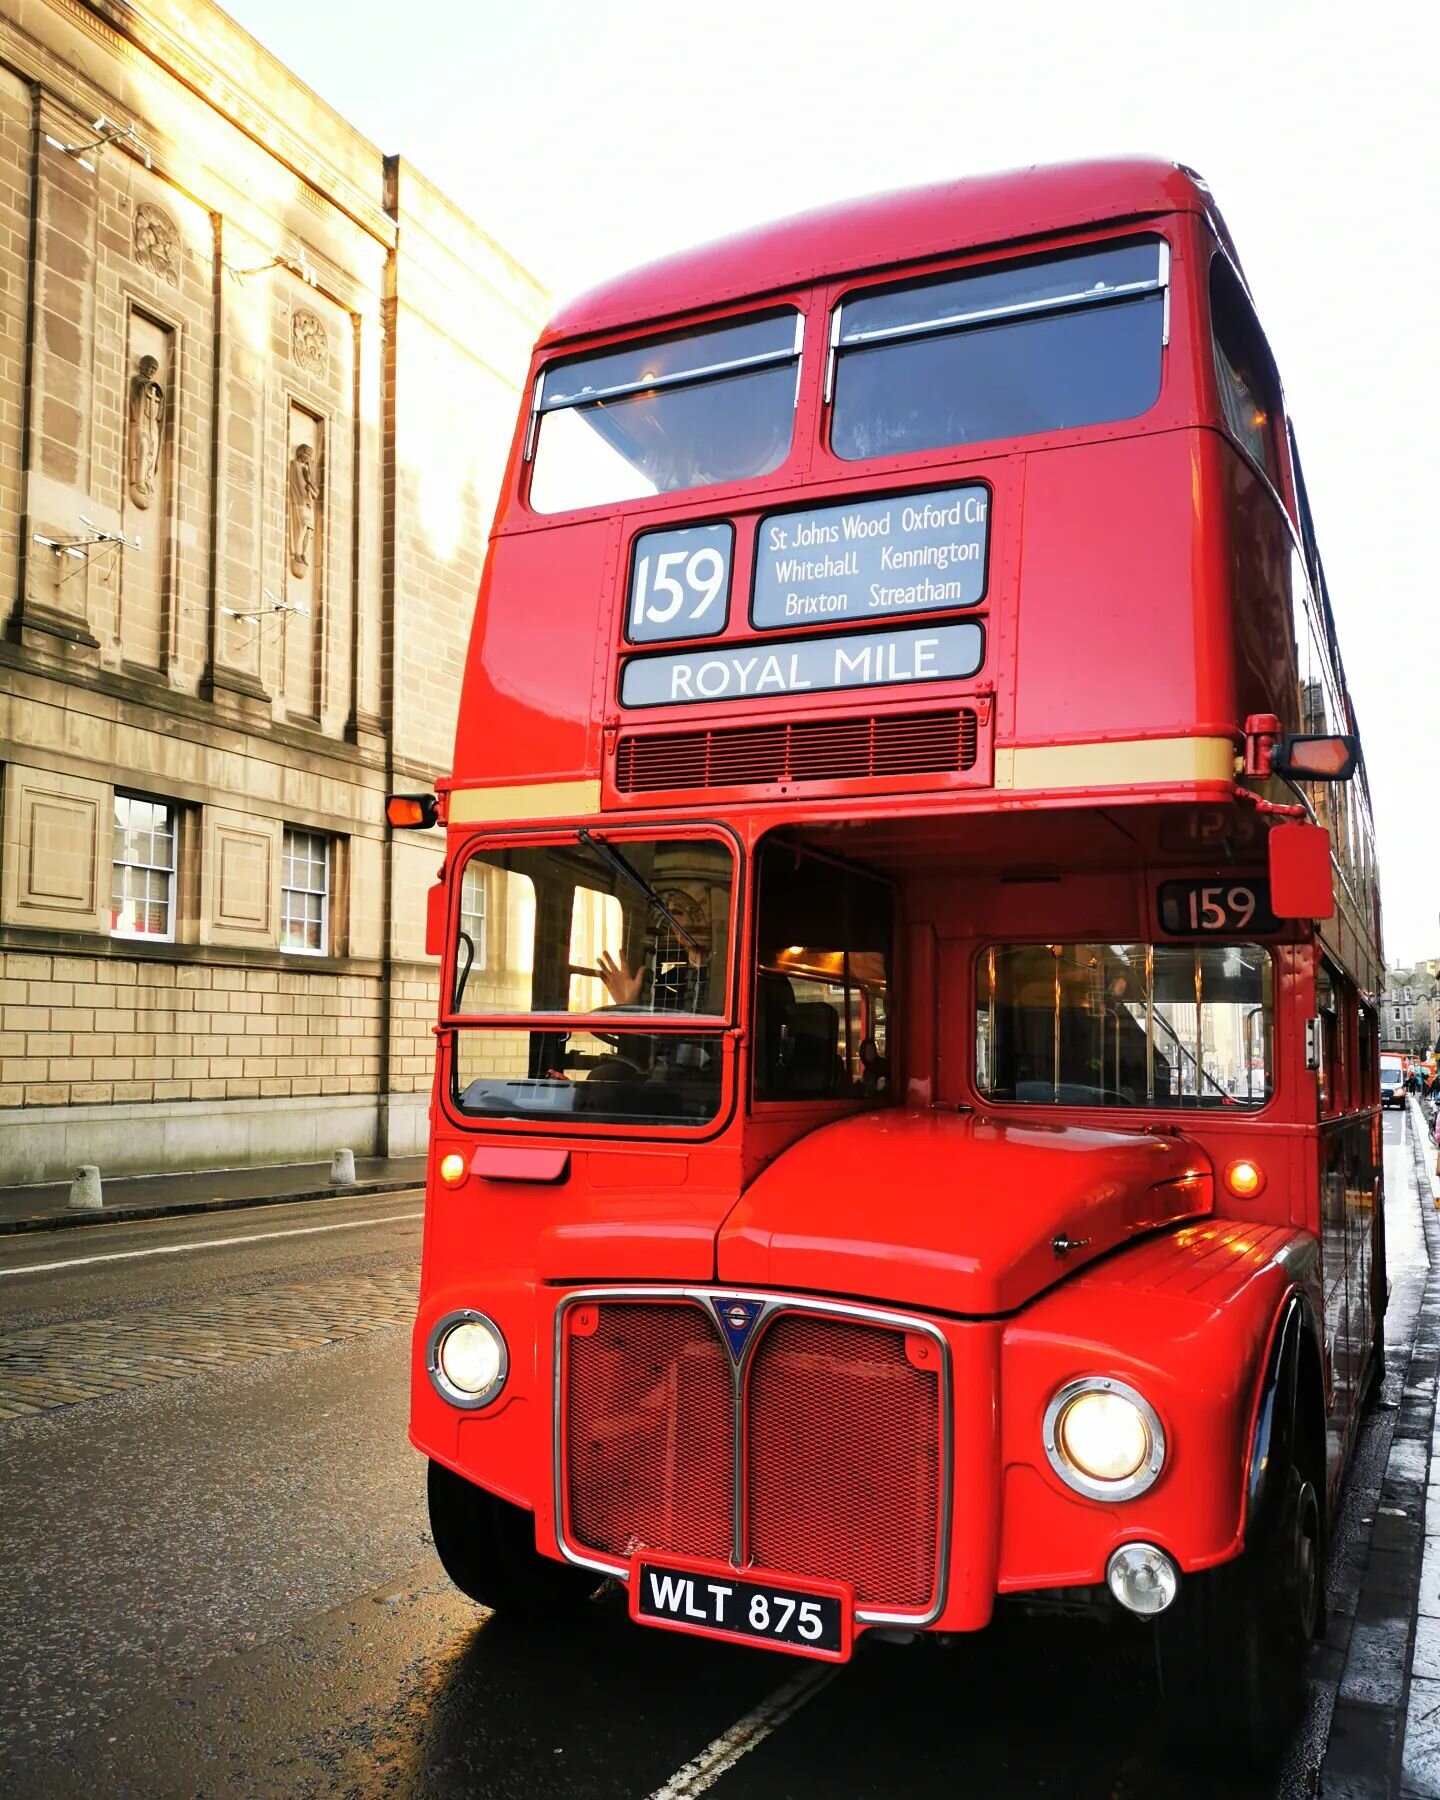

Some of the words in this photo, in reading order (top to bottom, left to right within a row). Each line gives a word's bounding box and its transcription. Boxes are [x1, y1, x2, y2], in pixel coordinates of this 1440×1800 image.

[770, 527, 787, 551] St
[792, 520, 839, 547] Johns
[842, 512, 890, 540] Wood
[902, 507, 960, 532] Oxford
[776, 552, 859, 584] Whitehall
[881, 542, 979, 570] Kennington
[633, 548, 724, 625] 159
[785, 592, 847, 616] Brixton
[868, 580, 960, 607] Streatham
[671, 654, 811, 699] ROYAL
[834, 639, 939, 683] MILE
[1189, 888, 1255, 929] 159
[650, 1573, 732, 1622] WLT
[749, 1595, 823, 1639] 875
